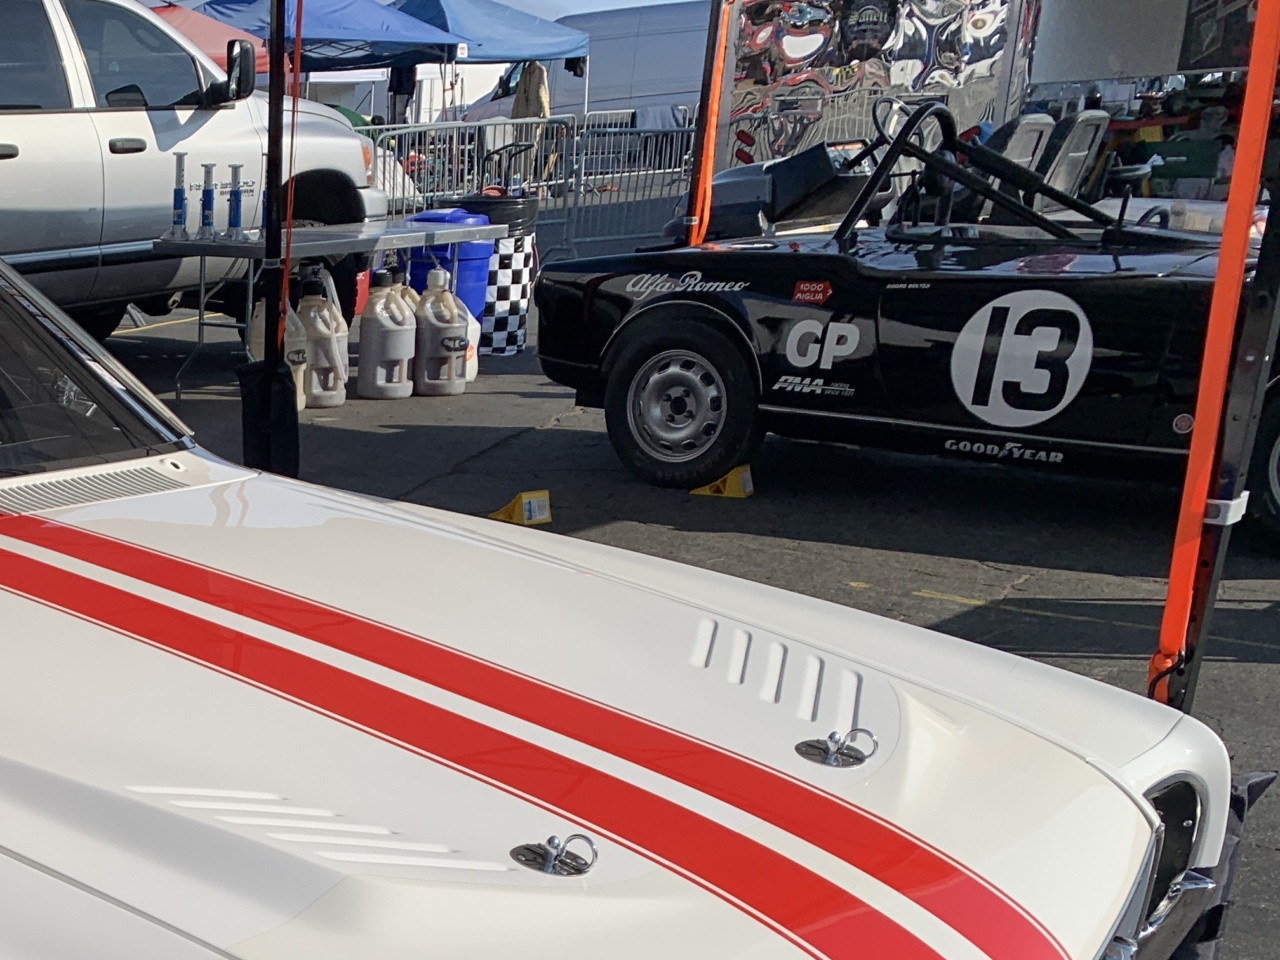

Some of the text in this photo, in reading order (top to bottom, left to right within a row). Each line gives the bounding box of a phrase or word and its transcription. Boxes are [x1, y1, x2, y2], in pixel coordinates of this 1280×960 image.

[626, 271, 750, 300] Alfa Romeo
[795, 292, 823, 300] MIGLIA
[800, 283, 824, 291] 1000
[786, 319, 860, 369] GP
[971, 306, 1081, 412] 13
[944, 439, 1064, 463] GOODYEAR
